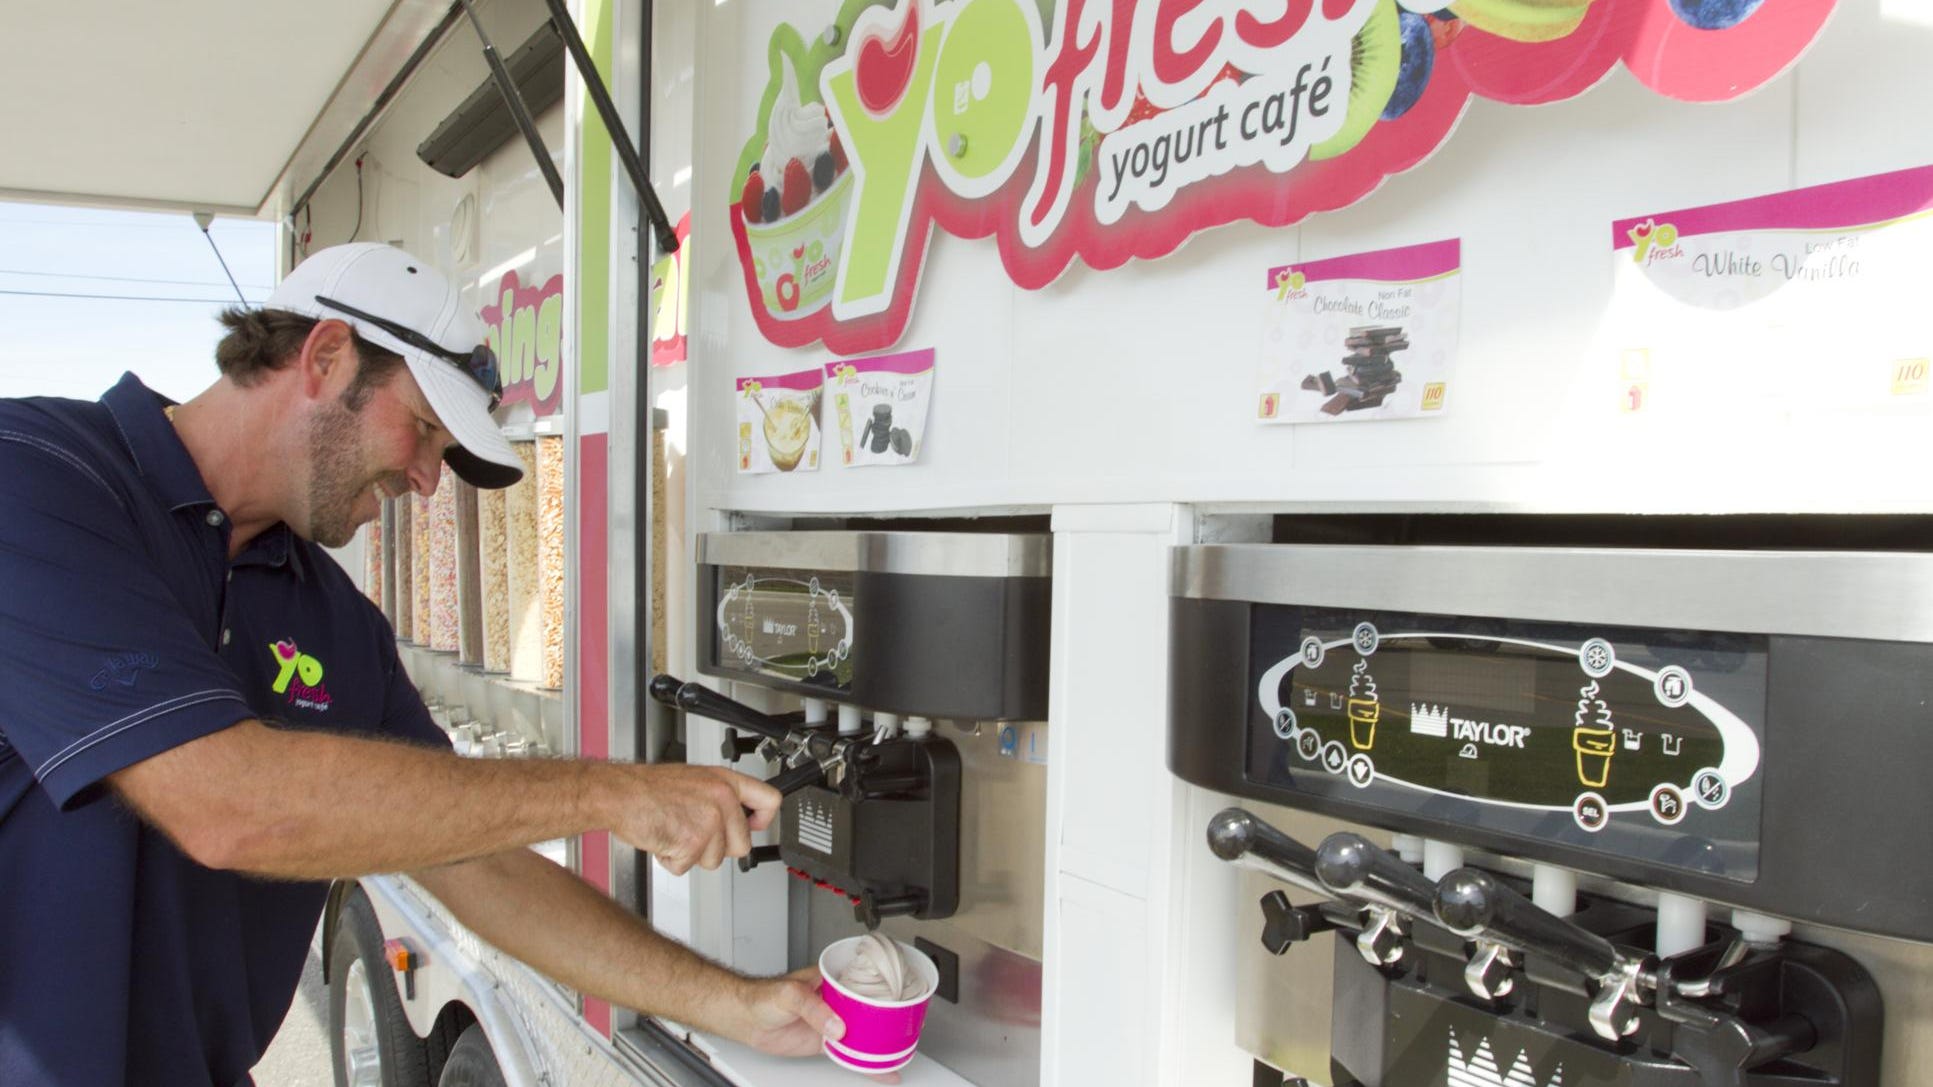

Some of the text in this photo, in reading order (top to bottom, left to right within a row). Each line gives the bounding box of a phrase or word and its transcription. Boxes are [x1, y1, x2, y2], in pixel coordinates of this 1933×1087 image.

[1108, 55, 1333, 201] yogurt café
[1647, 243, 1684, 266] fresh
[1692, 252, 1860, 281] White Vanilla
[803, 253, 831, 288] fresh
[1314, 295, 1411, 320] Chocolate Classic
[1378, 289, 1396, 301] Non
[487, 287, 562, 401] ing
[1896, 362, 1924, 383] 110
[1425, 386, 1443, 401] 110
[288, 677, 333, 703] fresh
